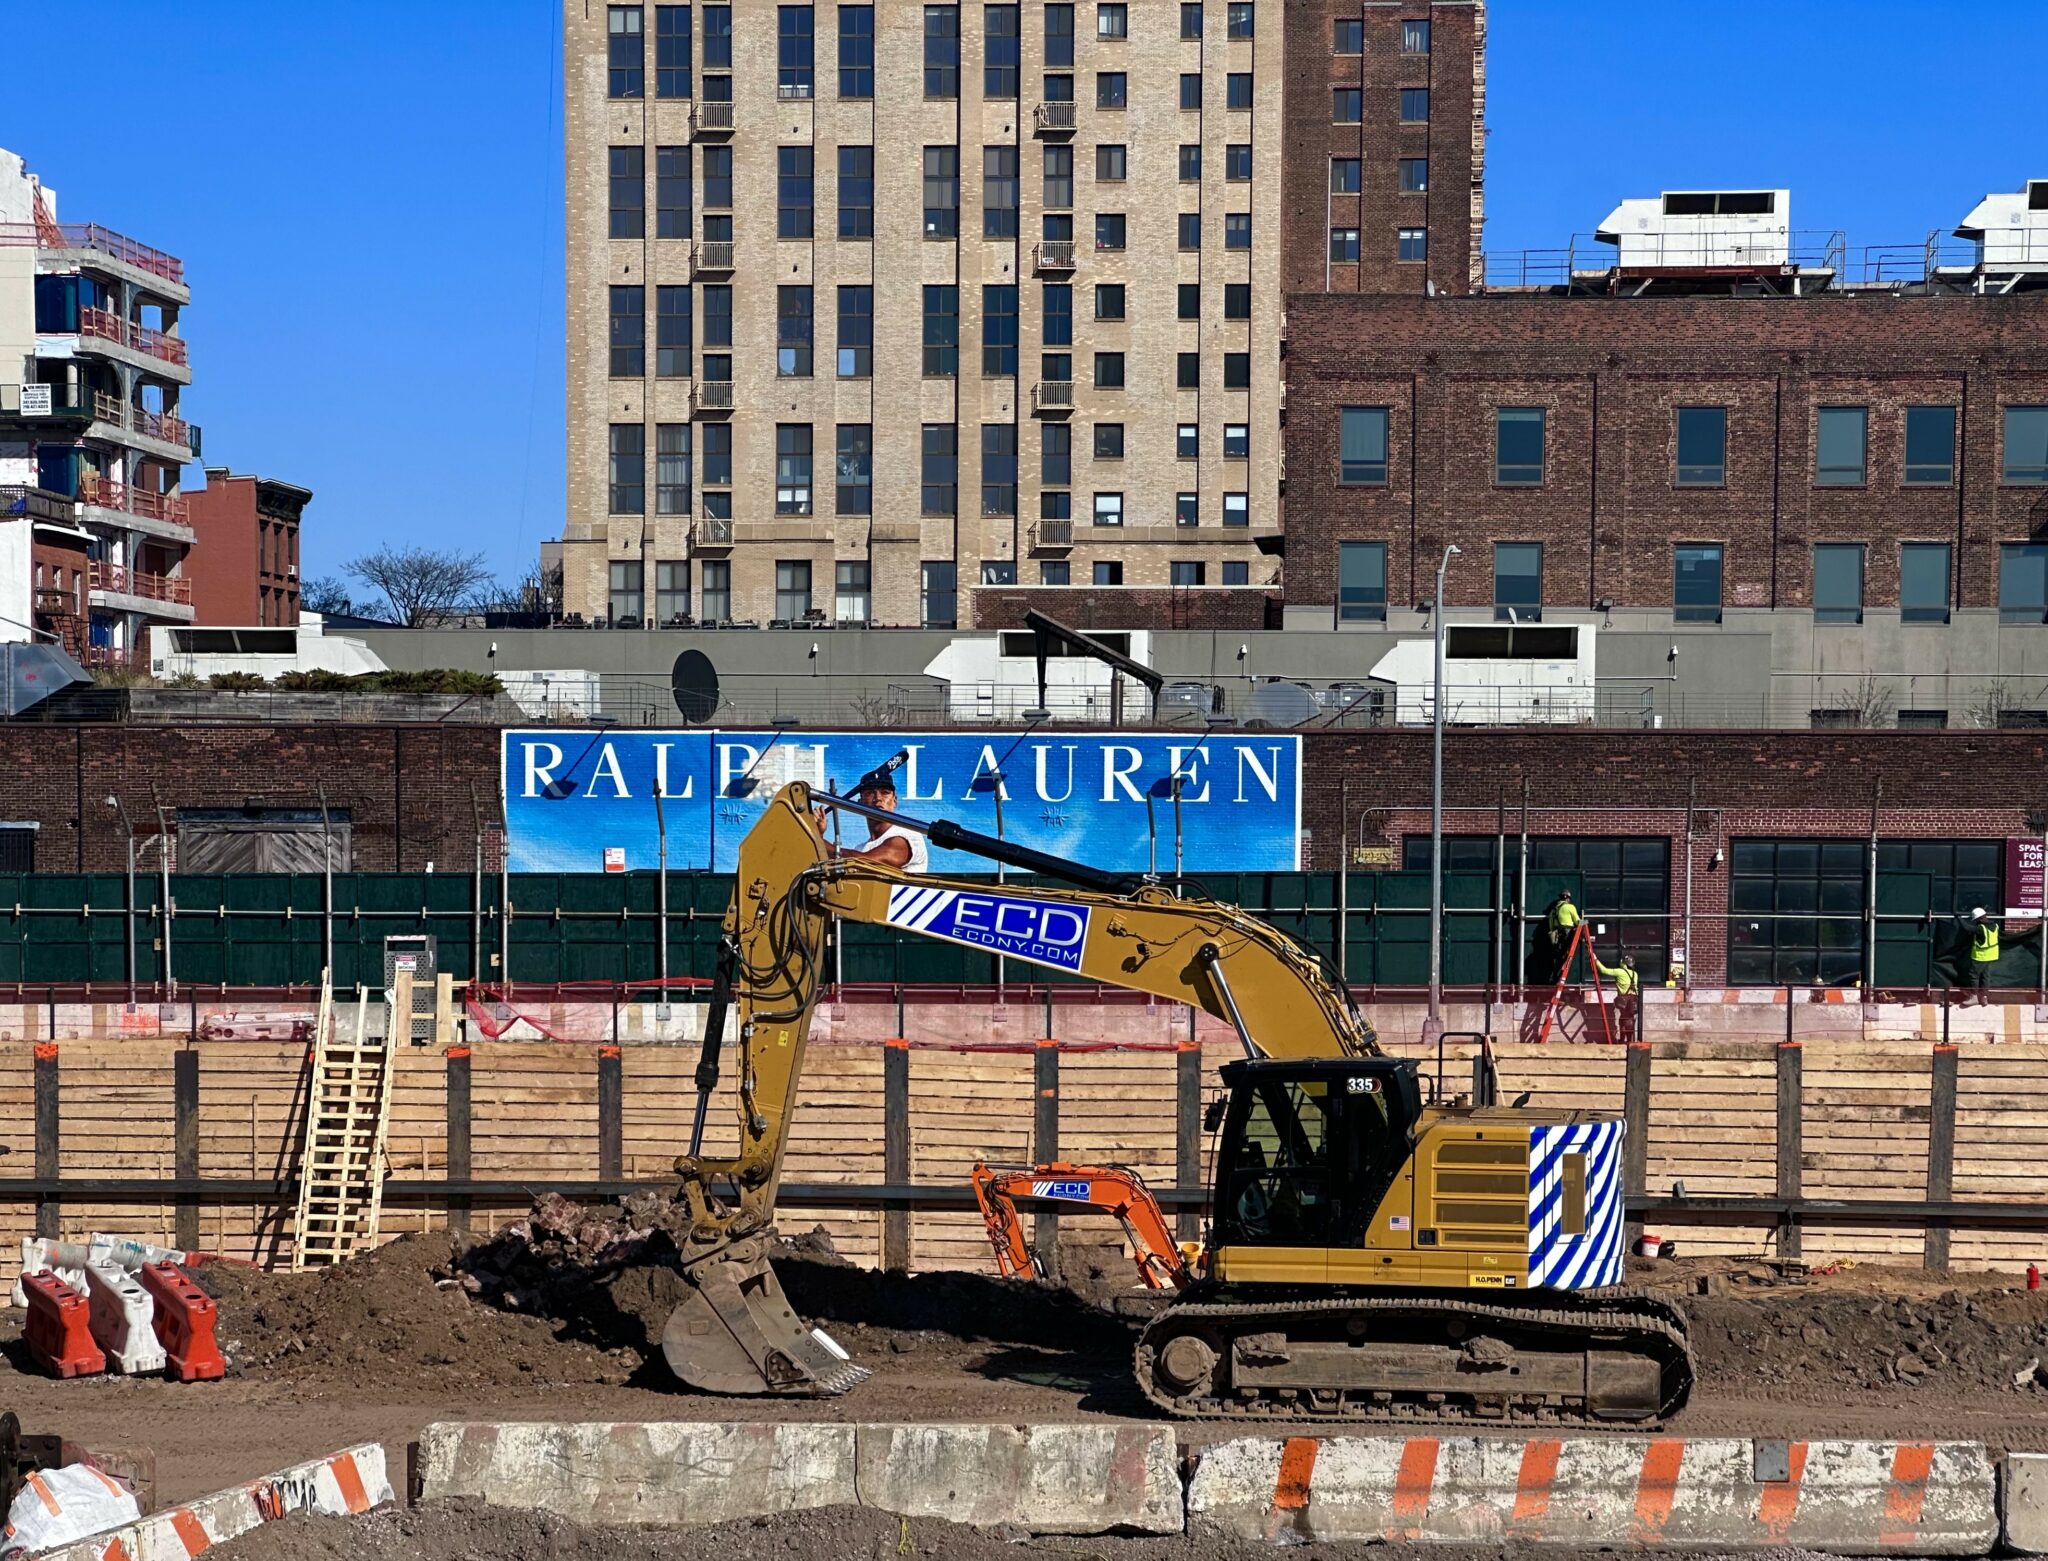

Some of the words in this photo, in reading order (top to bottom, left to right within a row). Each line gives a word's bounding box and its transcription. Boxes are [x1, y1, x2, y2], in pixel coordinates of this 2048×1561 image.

[520, 742, 829, 798] RALPH
[902, 745, 1282, 802] LAUREN
[2019, 844, 2043, 852] SPAC
[2023, 852, 2043, 860] FOR
[954, 898, 1083, 946] ECD
[952, 927, 1079, 964] ECDNY.COM
[1348, 1078, 1373, 1092] 335
[1053, 1183, 1089, 1195] ECD
